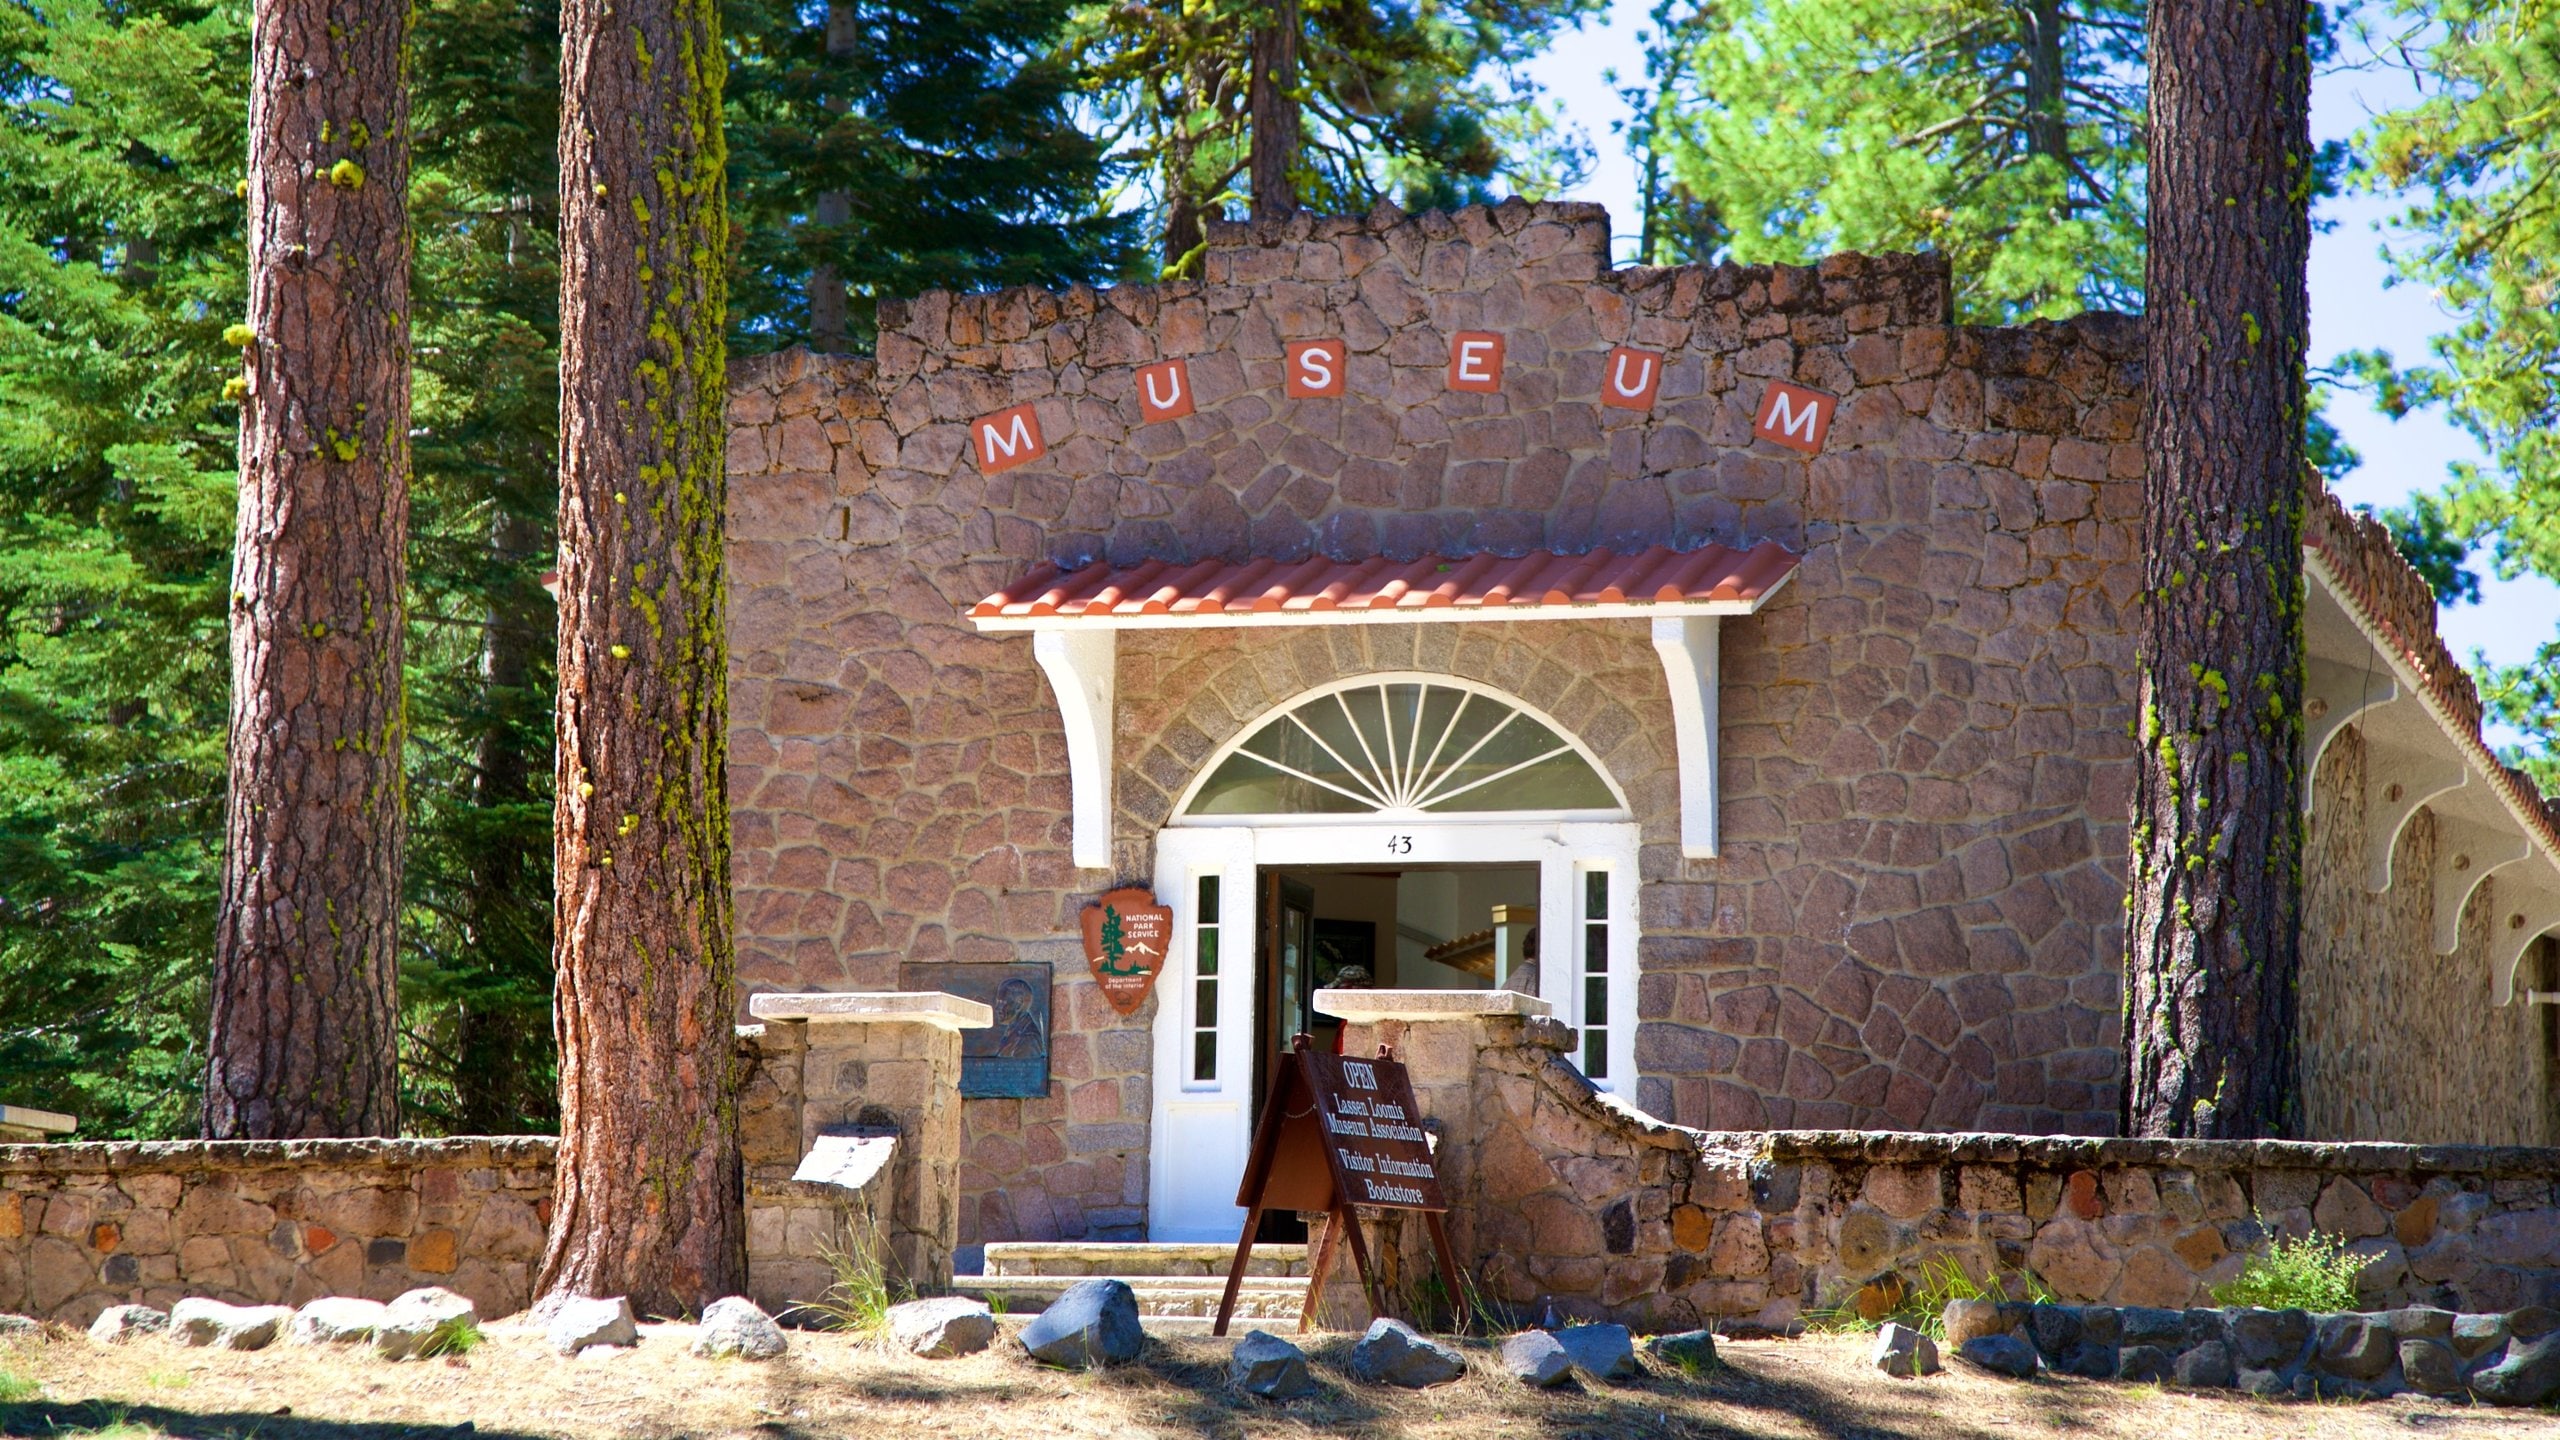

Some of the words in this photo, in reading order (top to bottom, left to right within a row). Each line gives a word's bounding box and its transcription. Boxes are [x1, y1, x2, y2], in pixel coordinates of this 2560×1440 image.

[982, 338, 1820, 464] MUSEUM
[1387, 834, 1413, 855] 43
[1126, 914, 1164, 922] NATIONAL
[1133, 922, 1154, 930] PARK
[1127, 930, 1159, 939] SERVICE
[1343, 1060, 1378, 1091] OPEN
[1333, 1093, 1368, 1116] Lassen
[1367, 1097, 1405, 1120] Loomis
[1326, 1112, 1368, 1137] Museum
[1370, 1118, 1424, 1142] Association
[1338, 1148, 1375, 1172] Visitor
[1376, 1153, 1434, 1178] Information
[1364, 1178, 1424, 1203] Bookstore
